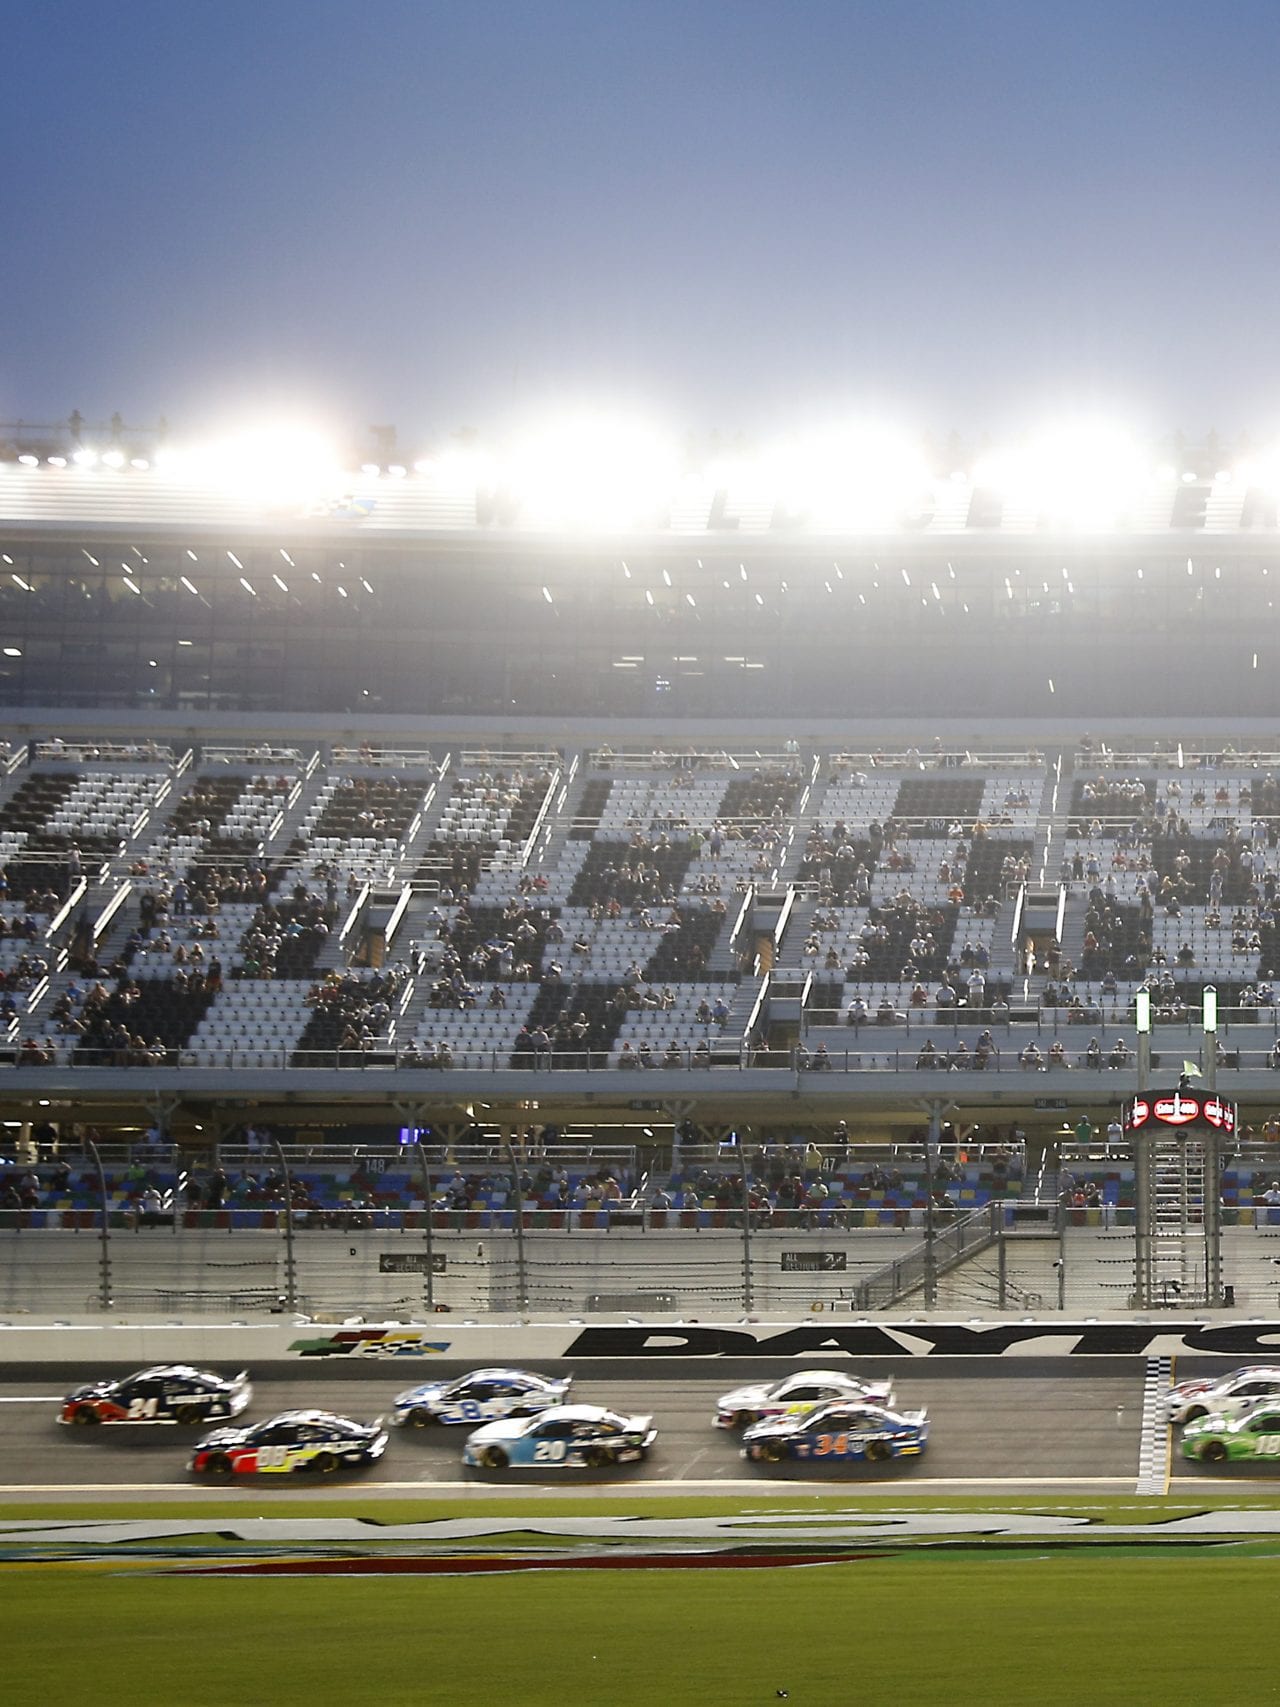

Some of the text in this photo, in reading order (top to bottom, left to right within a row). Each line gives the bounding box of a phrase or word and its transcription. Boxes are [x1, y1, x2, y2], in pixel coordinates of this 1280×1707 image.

[365, 1158, 386, 1174] 148
[785, 1253, 798, 1262] ALL
[127, 1398, 159, 1418] 24
[460, 1399, 482, 1420] 8
[533, 1440, 567, 1461] 20
[814, 1433, 849, 1455] 34
